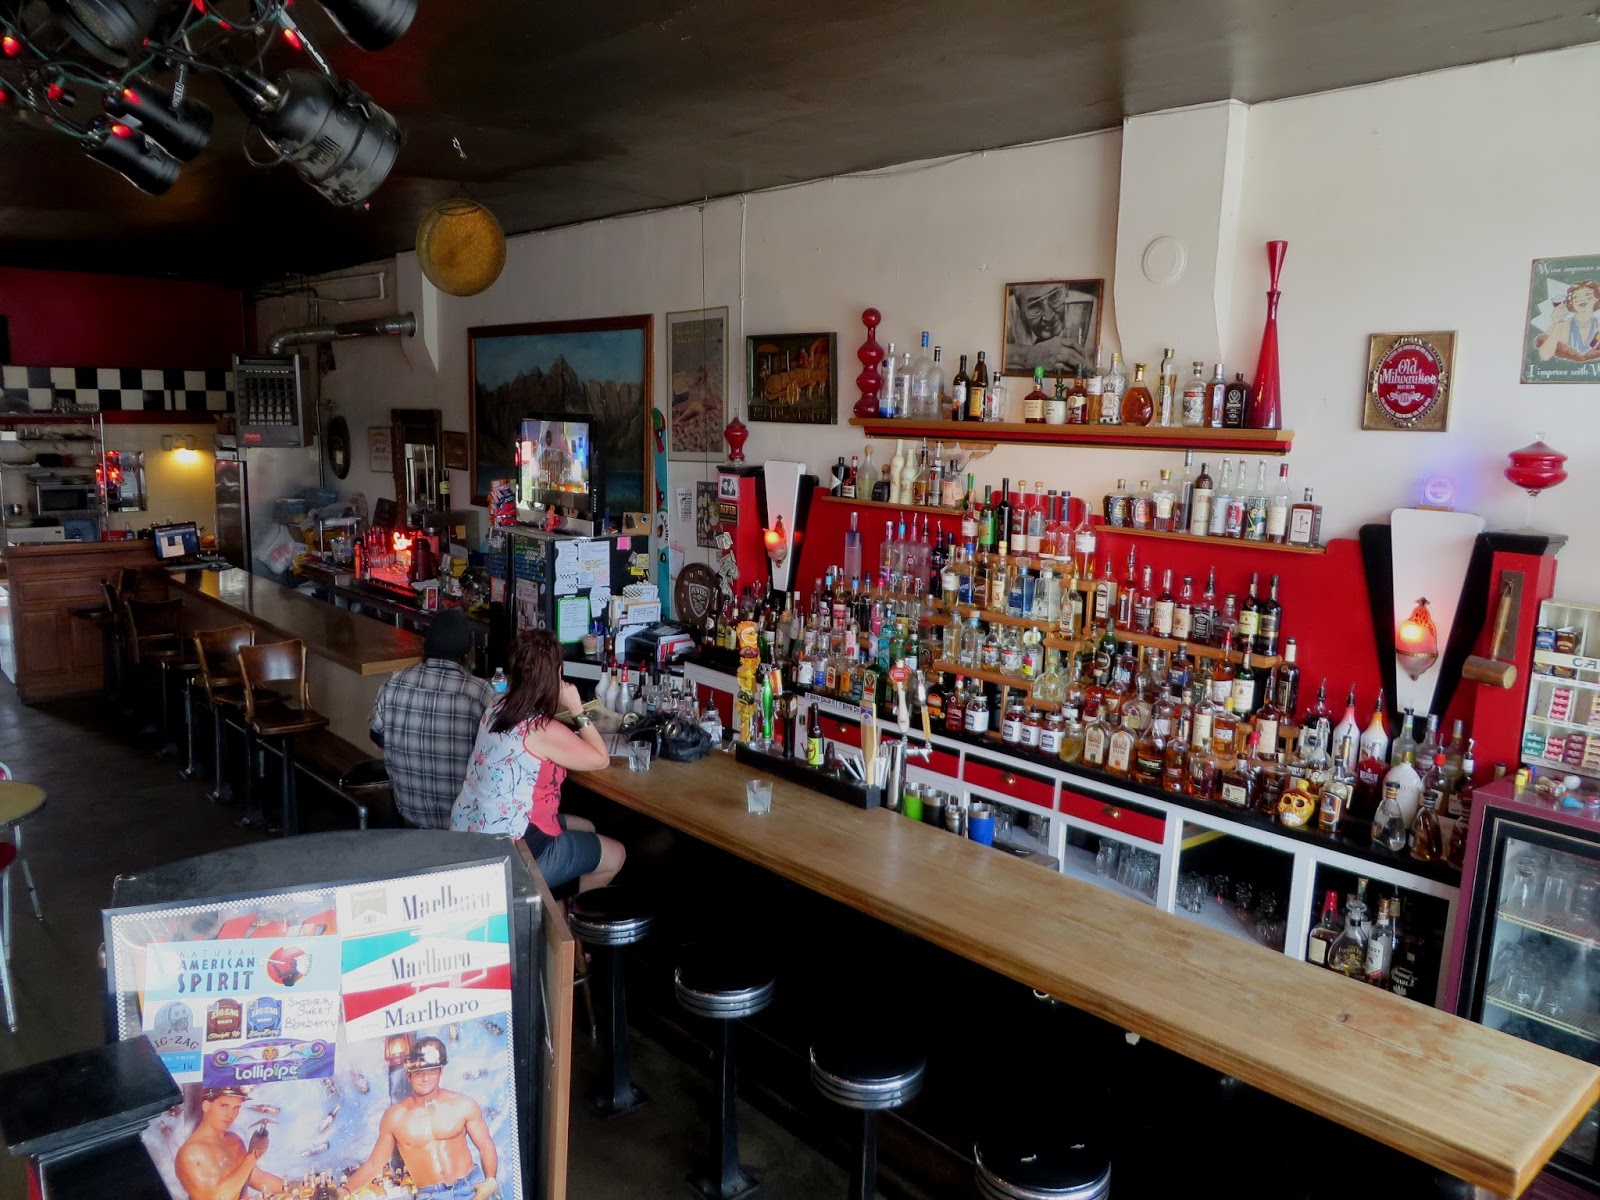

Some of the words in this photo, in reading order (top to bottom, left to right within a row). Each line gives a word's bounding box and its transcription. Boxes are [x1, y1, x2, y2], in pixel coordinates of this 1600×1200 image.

[1398, 358, 1419, 375] Old
[1380, 368, 1438, 385] Milwaukee
[179, 948, 255, 959] NATURAL
[179, 957, 256, 971] AMERICAN
[391, 947, 471, 981] Marlboro
[178, 971, 254, 993] SPIRIT
[384, 999, 480, 1029] Marlboro
[153, 1035, 200, 1050] IG-ZAG
[235, 1064, 300, 1082] Lollipipe
